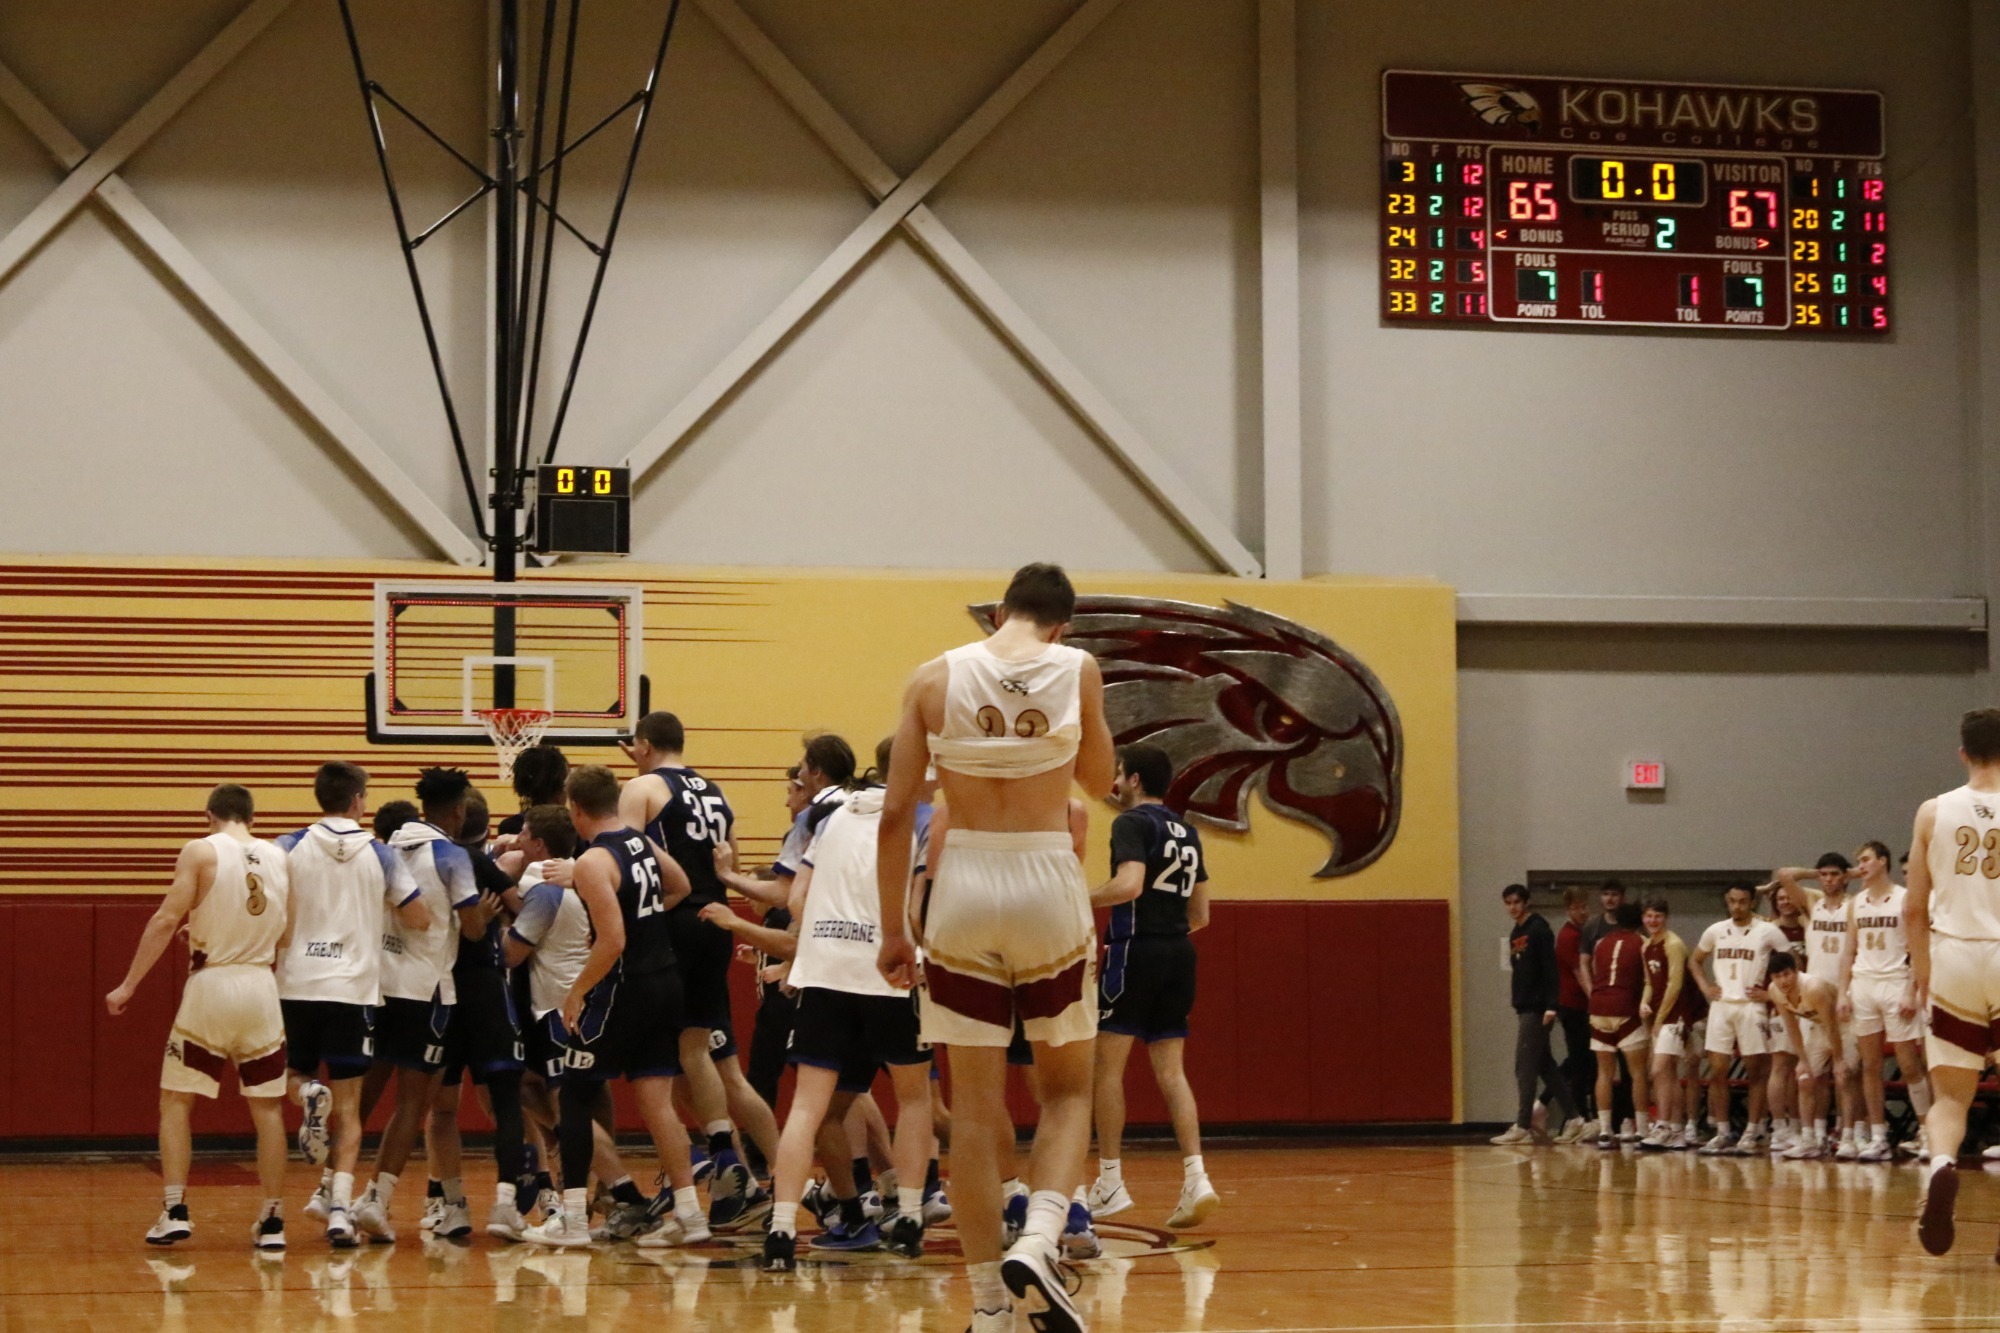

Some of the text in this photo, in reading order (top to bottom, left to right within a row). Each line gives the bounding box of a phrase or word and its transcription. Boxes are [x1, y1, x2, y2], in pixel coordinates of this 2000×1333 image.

[1561, 88, 1817, 132] KOHAWKS
[1560, 127, 1819, 150] Coe College
[1391, 143, 1482, 158] NO F PTS
[1402, 162, 1484, 184] 3 1 12
[1503, 155, 1554, 174] HOME
[1714, 164, 1782, 183] VISITOR
[1796, 159, 1882, 175] NO F PTS
[1812, 178, 1884, 200] 1 1 12
[1388, 194, 1484, 217] 23 2 12
[1509, 182, 1558, 220] 65
[1729, 190, 1777, 229] 67
[1602, 222, 1650, 237] PERIOD
[1793, 209, 1885, 231] 20 2 11
[1388, 226, 1485, 249] 24 1 4
[1520, 229, 1563, 243] BONUS
[1656, 218, 1675, 248] 2
[1715, 235, 1758, 250] BONUS
[1515, 253, 1557, 268] FOULS
[1793, 241, 1885, 264] 23 1 2
[1389, 259, 1485, 282] 32 2 5
[1723, 261, 1763, 275] FOULS
[1537, 270, 1556, 300] 7
[1594, 273, 1602, 302] 1
[1690, 276, 1698, 305] 1
[1744, 277, 1763, 307] 7
[1794, 273, 1886, 295] 25 0 4
[1390, 291, 1486, 314] 33 2 11
[1517, 304, 1557, 317] POINTS
[1580, 305, 1606, 318] TOL
[1676, 308, 1701, 322] TOL
[1725, 310, 1764, 324] POINTS
[1795, 305, 1887, 328] 35 1 5
[1634, 764, 1659, 784] EXIT
[682, 790, 727, 846] 35
[1955, 826, 2000, 879] 23
[1152, 839, 1199, 898] 23
[246, 871, 267, 916] 3
[631, 857, 664, 919] 25
[812, 920, 876, 943] SHERBURNE
[305, 941, 344, 959] KREJCI
